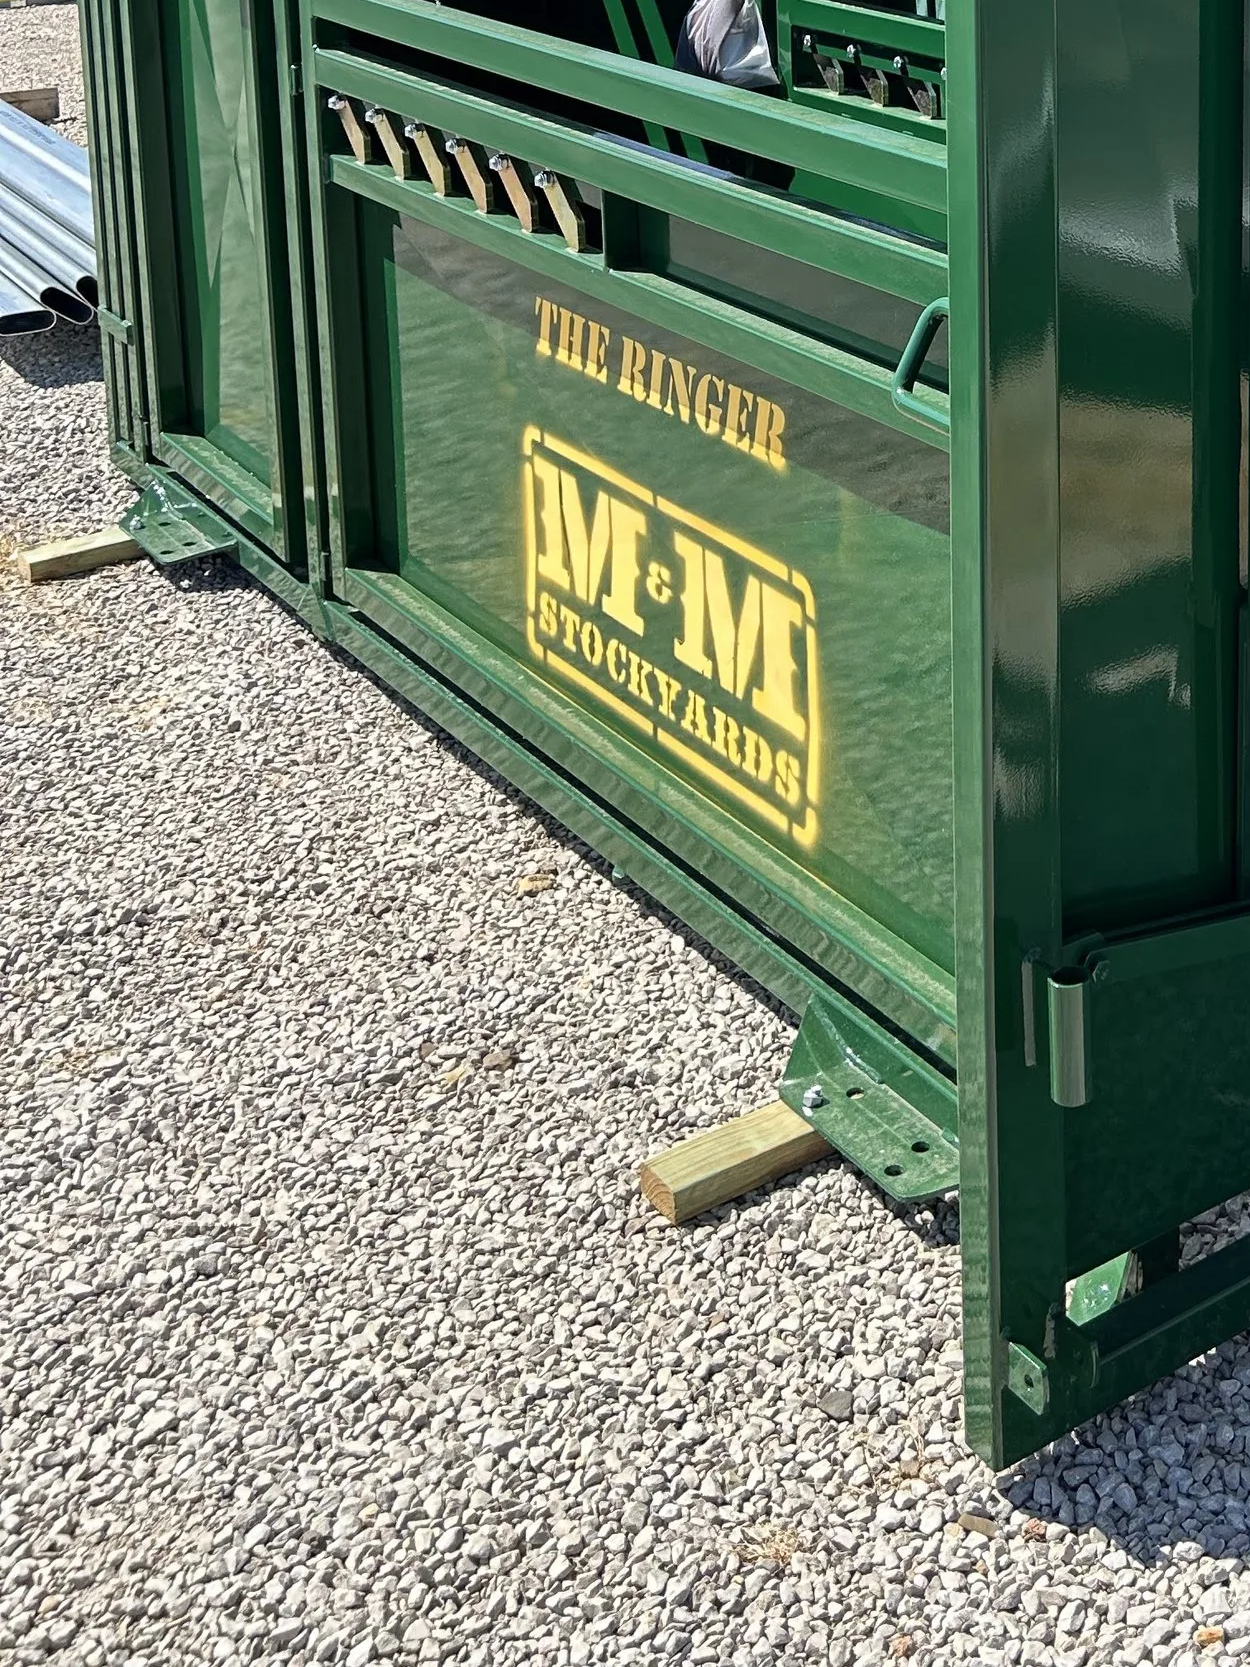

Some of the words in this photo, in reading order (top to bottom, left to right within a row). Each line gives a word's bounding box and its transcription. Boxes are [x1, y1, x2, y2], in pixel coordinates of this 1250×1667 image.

[535, 296, 611, 384] THE
[616, 334, 788, 471] RINGER
[533, 452, 807, 742] M&M
[537, 590, 801, 806] STOCKYARDS
